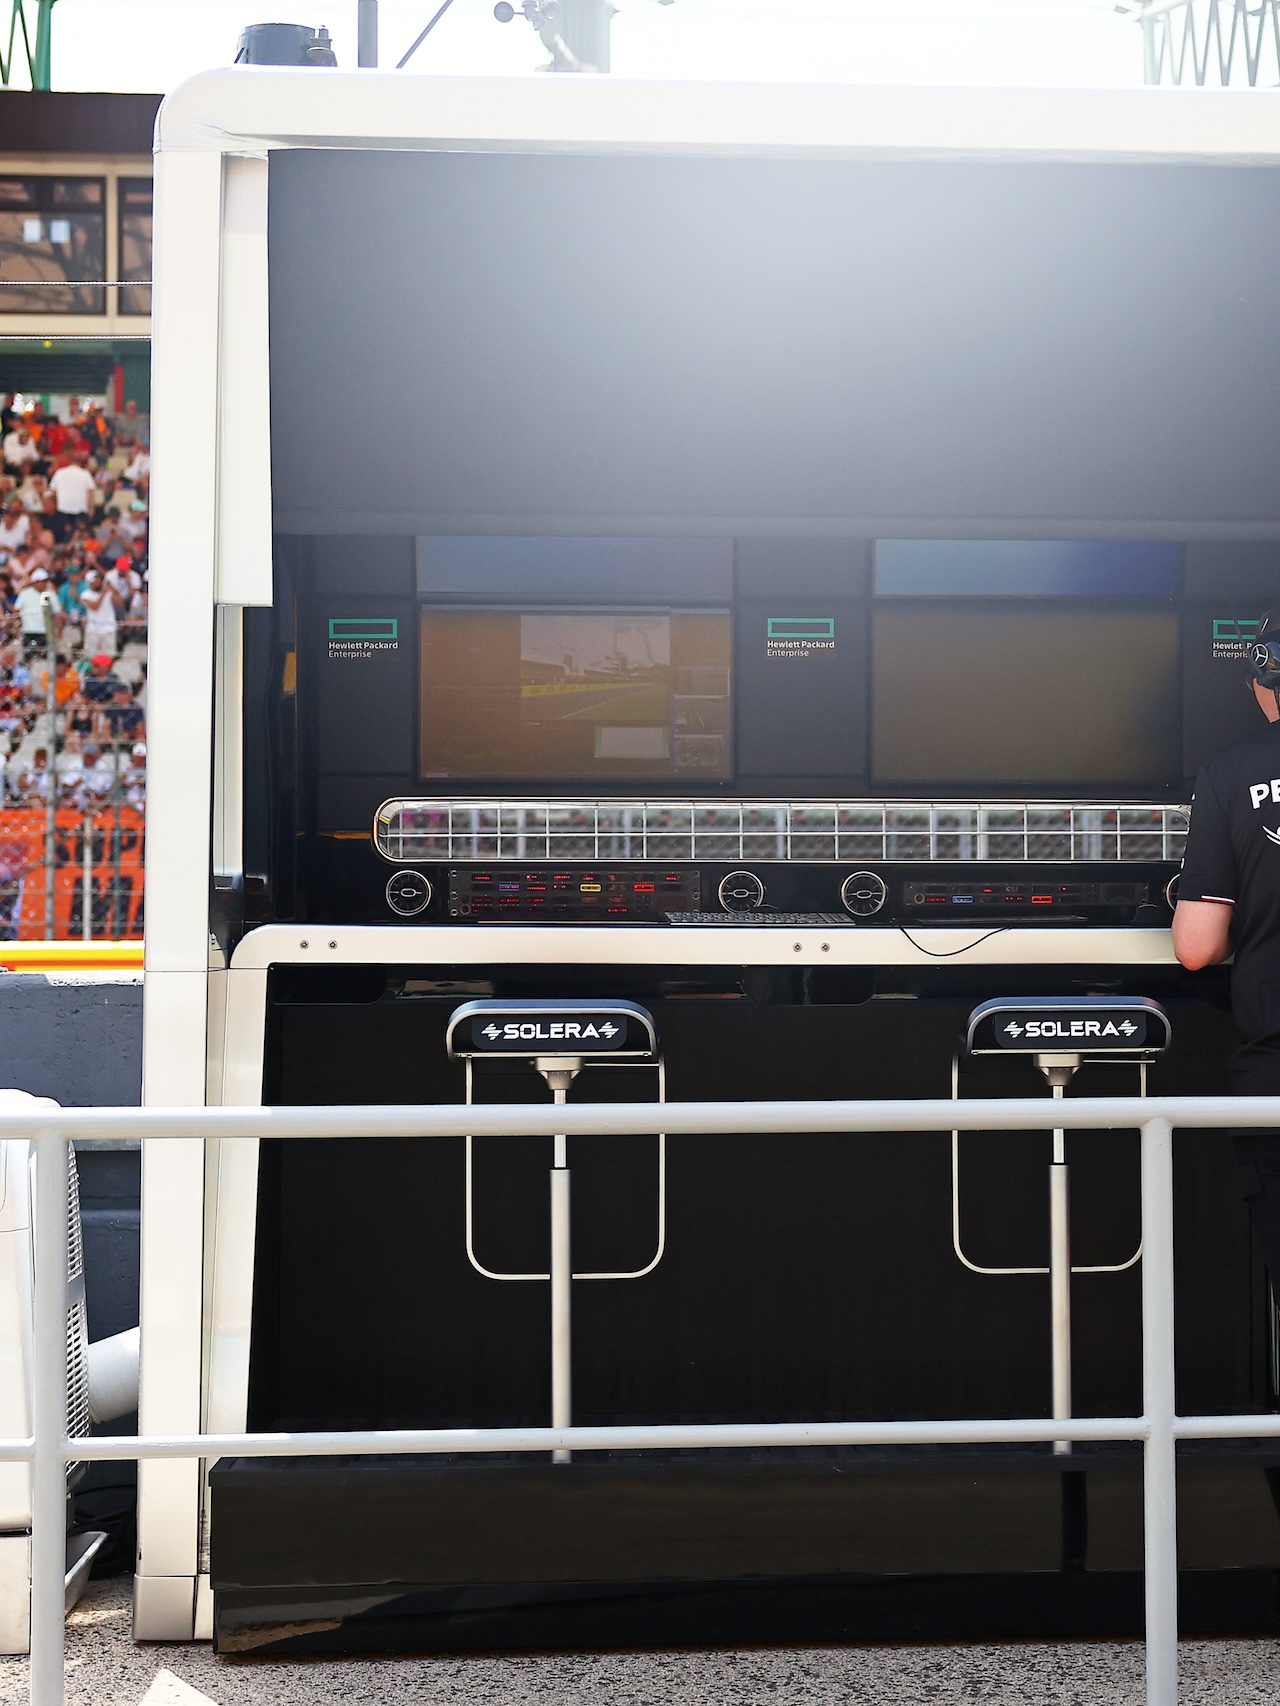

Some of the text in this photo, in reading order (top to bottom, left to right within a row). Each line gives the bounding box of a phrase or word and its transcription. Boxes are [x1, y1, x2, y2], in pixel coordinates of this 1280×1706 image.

[328, 641, 399, 650] Hewlett Packard
[767, 640, 835, 649] Hewlett Packard
[1213, 642, 1244, 650] Hewlet
[328, 650, 372, 659] Enterprise
[767, 649, 810, 658] Enterprise
[43, 828, 145, 868] SUP
[503, 1022, 600, 1040] SOLERA
[1025, 1020, 1120, 1038] SOLERA
